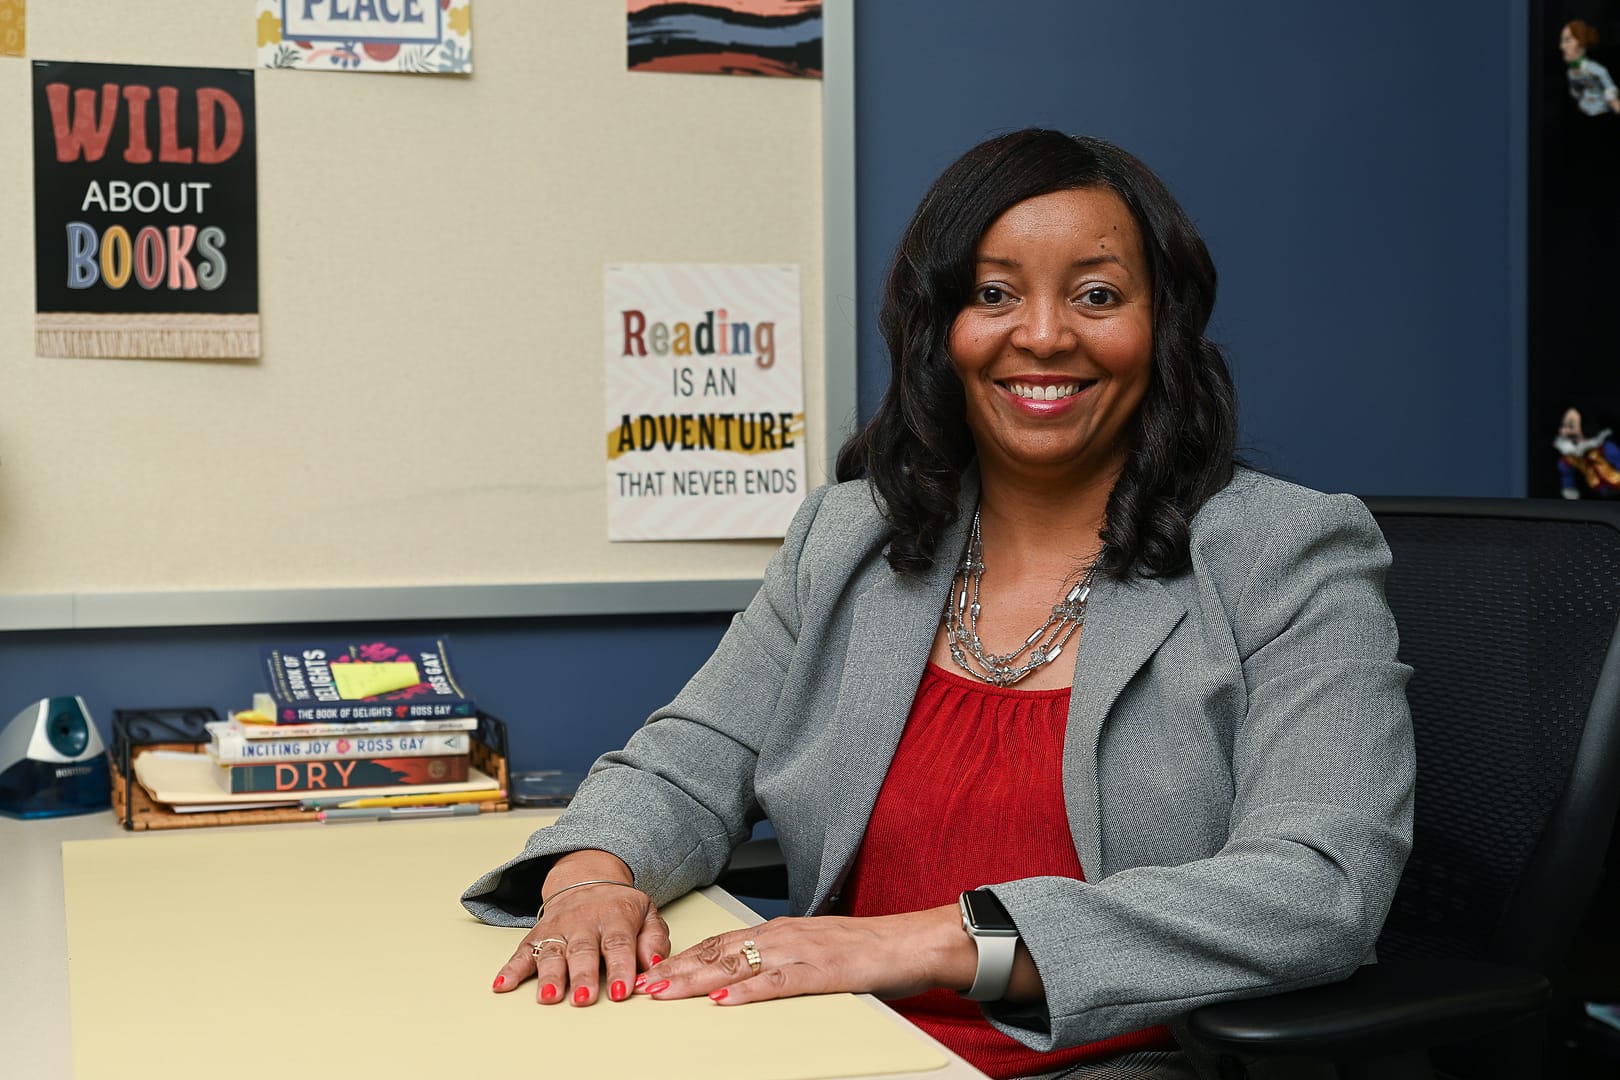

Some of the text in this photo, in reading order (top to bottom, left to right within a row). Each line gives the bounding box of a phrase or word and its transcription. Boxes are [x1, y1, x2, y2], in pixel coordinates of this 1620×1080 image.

[302, 0, 424, 23] PLACE
[46, 83, 244, 164] WILD
[81, 181, 212, 213] ABOUT
[66, 222, 228, 290] BOOKS
[621, 308, 775, 370] Reading
[673, 367, 736, 397] IS AN
[617, 412, 795, 452] ADVENTURE
[617, 468, 797, 497] THAT NEVER ENDS
[303, 649, 340, 701] DELIGHTS
[420, 652, 443, 675] GAY
[297, 704, 452, 720] THE BOOK OF DELIGHTS ROSS GAY
[242, 737, 425, 757] INCITING JOY ROSS GAY
[275, 761, 357, 791] DRY
